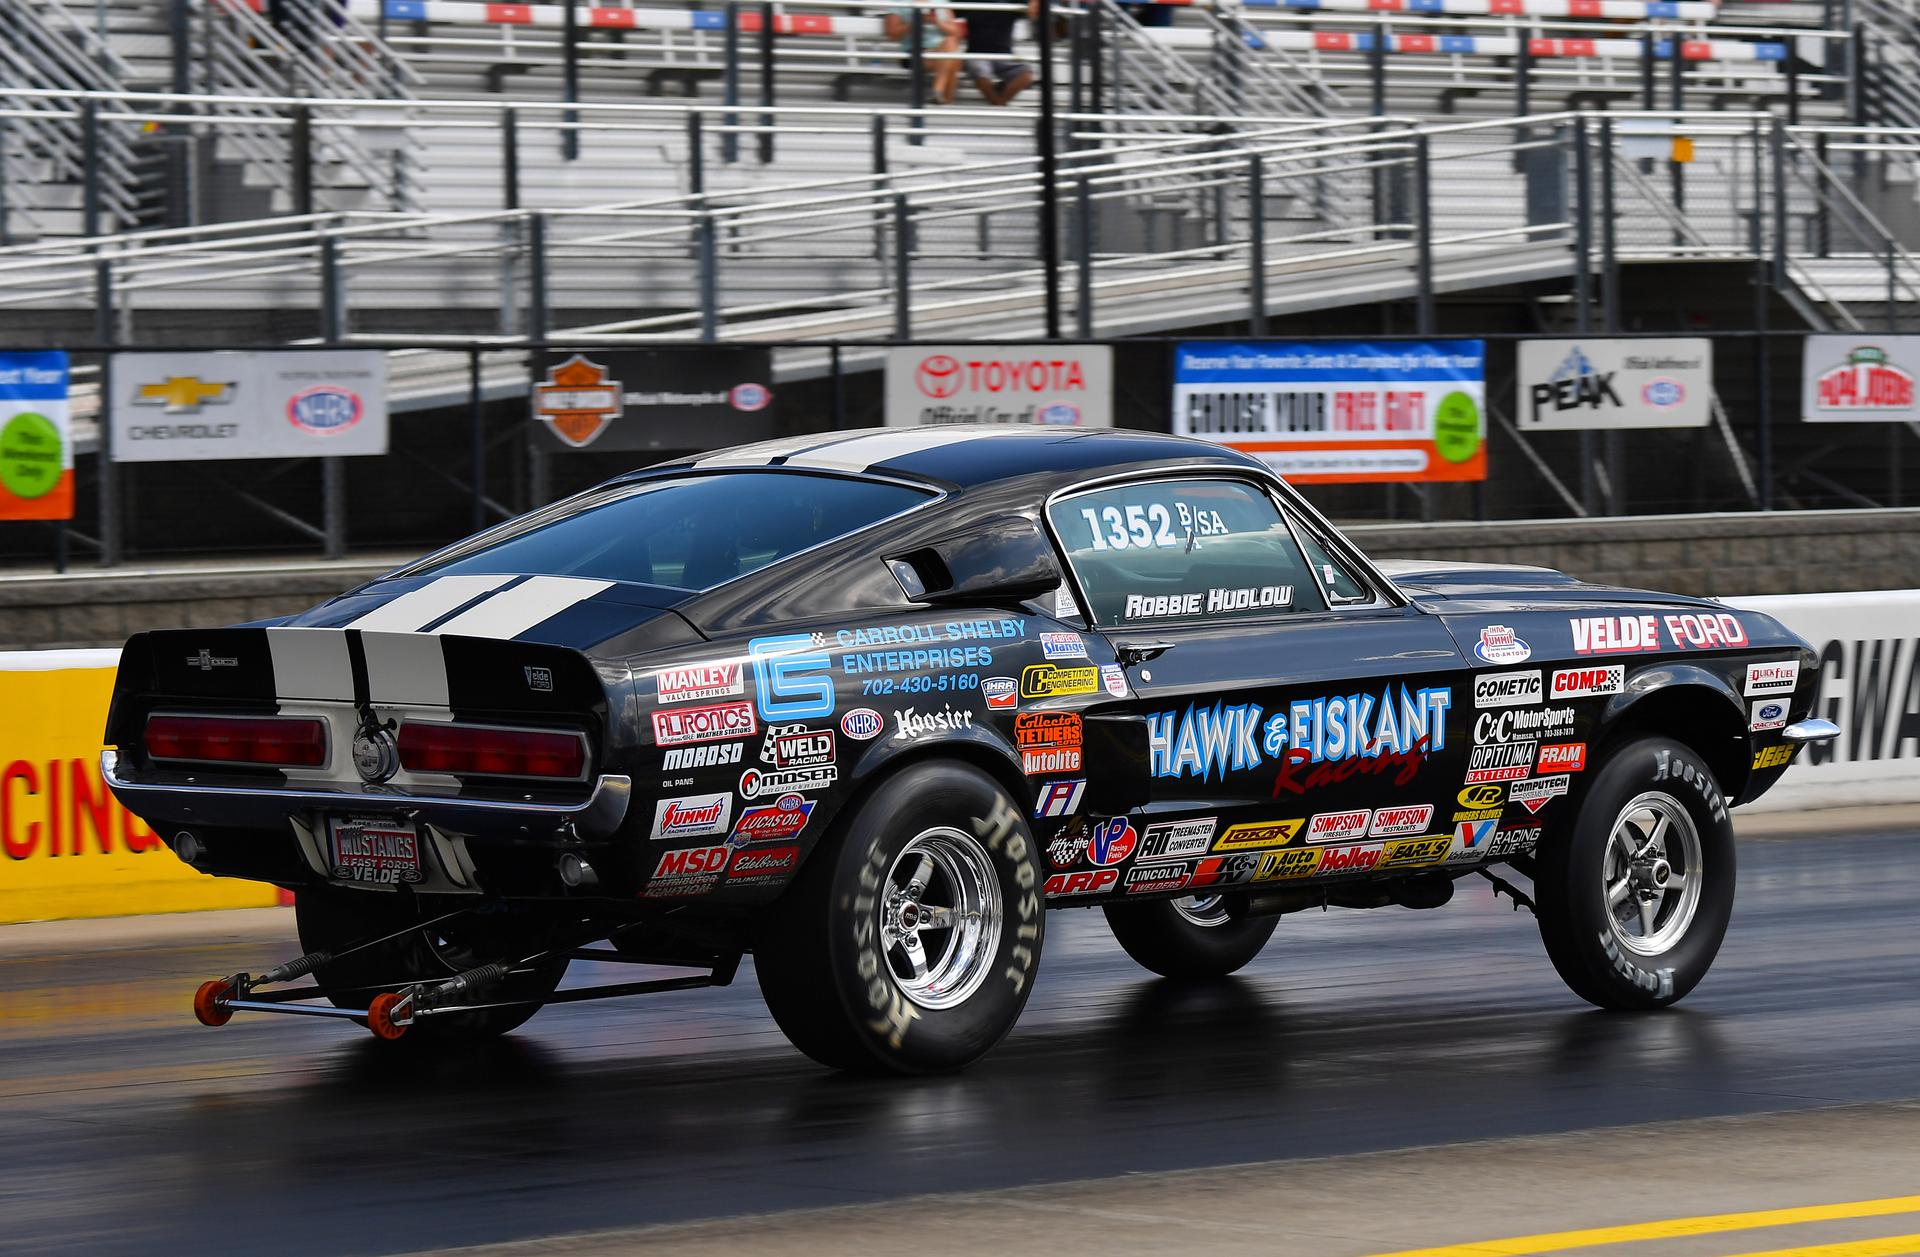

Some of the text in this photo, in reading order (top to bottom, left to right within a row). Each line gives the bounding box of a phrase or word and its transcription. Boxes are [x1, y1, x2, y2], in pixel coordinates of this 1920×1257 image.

[967, 359, 1086, 392] TOYOTA
[1531, 371, 1624, 422] PEAK
[1272, 392, 1327, 432] YOUR
[129, 424, 238, 440] CHEVROLET
[1081, 503, 1177, 552] 1352
[1125, 585, 1294, 619] ROBBIE HUDLOW
[836, 619, 1026, 648] CARROLL SHELBY
[1570, 613, 1749, 655] VELDE FORD
[1044, 641, 1085, 655] Strange
[842, 646, 993, 674] ENTERPRISES
[659, 666, 731, 691] MANLEY
[1047, 669, 1095, 680] COMPETITION
[1555, 670, 1607, 692] COMP
[1775, 668, 1794, 679] FUEL
[862, 673, 979, 696] 702-430-5160
[986, 681, 1015, 690] IHRA
[1047, 678, 1094, 689] ENGINEERING
[1476, 677, 1540, 698] COMETIC
[1591, 684, 1617, 693] CAMS
[666, 687, 731, 701] VALVE SPRINGS
[657, 705, 752, 738] ALTRONICS
[893, 702, 973, 740] Hoosier
[1017, 712, 1080, 729] Collector
[1762, 708, 1779, 718] Ford
[696, 730, 723, 739] WEATHER
[724, 727, 752, 736] STATIONS
[847, 715, 878, 733] NHRA
[1474, 707, 1575, 745] C&C MotorSports
[1752, 720, 1786, 730] RACING
[1018, 726, 1080, 743] TETHERS
[1148, 697, 1263, 784] HAWK
[1264, 713, 1289, 758] &
[1513, 732, 1537, 741] Manassas,
[662, 742, 744, 771] MOROSO
[778, 737, 831, 759] WELD
[1472, 743, 1534, 769] OPTIMA
[1539, 746, 1582, 764] FRAM
[1752, 744, 1795, 770] JEGS
[788, 755, 828, 766] RACING
[1025, 750, 1079, 772] Autolite
[1272, 733, 1431, 800] Racing
[662, 778, 694, 788] OIL PANS
[762, 768, 837, 787] MOSER
[1468, 767, 1528, 782] BATTERIES
[760, 780, 829, 794] ENGINEERING
[1511, 777, 1568, 794] COMPUTECH
[1652, 750, 1727, 824] Hoosier
[779, 798, 802, 810] NHRA
[741, 813, 800, 830] LUCAS OIL
[1312, 813, 1367, 833] SIMPSON
[1375, 809, 1429, 828] SIMPSON
[1452, 809, 1504, 822] RINGERS GLOVES
[1093, 816, 1129, 865] VP
[1139, 824, 1213, 857] ATI TREEMASTER
[1222, 825, 1291, 844] LOKAR
[1322, 829, 1352, 838] FIRESUITS
[1493, 828, 1541, 845] RACING
[341, 834, 415, 858] MUSTANGS
[1046, 837, 1090, 853] Jiffy-tite
[1110, 844, 1128, 852] Racing
[1168, 837, 1207, 852] CONVERTER
[1390, 840, 1447, 860] EARL'S
[351, 858, 378, 867] FAST
[381, 860, 416, 870] FORDS
[657, 848, 728, 878] MSD
[734, 853, 792, 872] Edelbrock
[1278, 851, 1314, 865] Auto
[1318, 846, 1382, 872] Holley
[353, 867, 401, 884] VELDE
[1130, 867, 1182, 882] LINCOLN
[1271, 862, 1317, 877] Meter
[1043, 869, 1119, 895] ARP
[1135, 880, 1182, 892] WELDERS
[970, 791, 1040, 995] Hoosier
